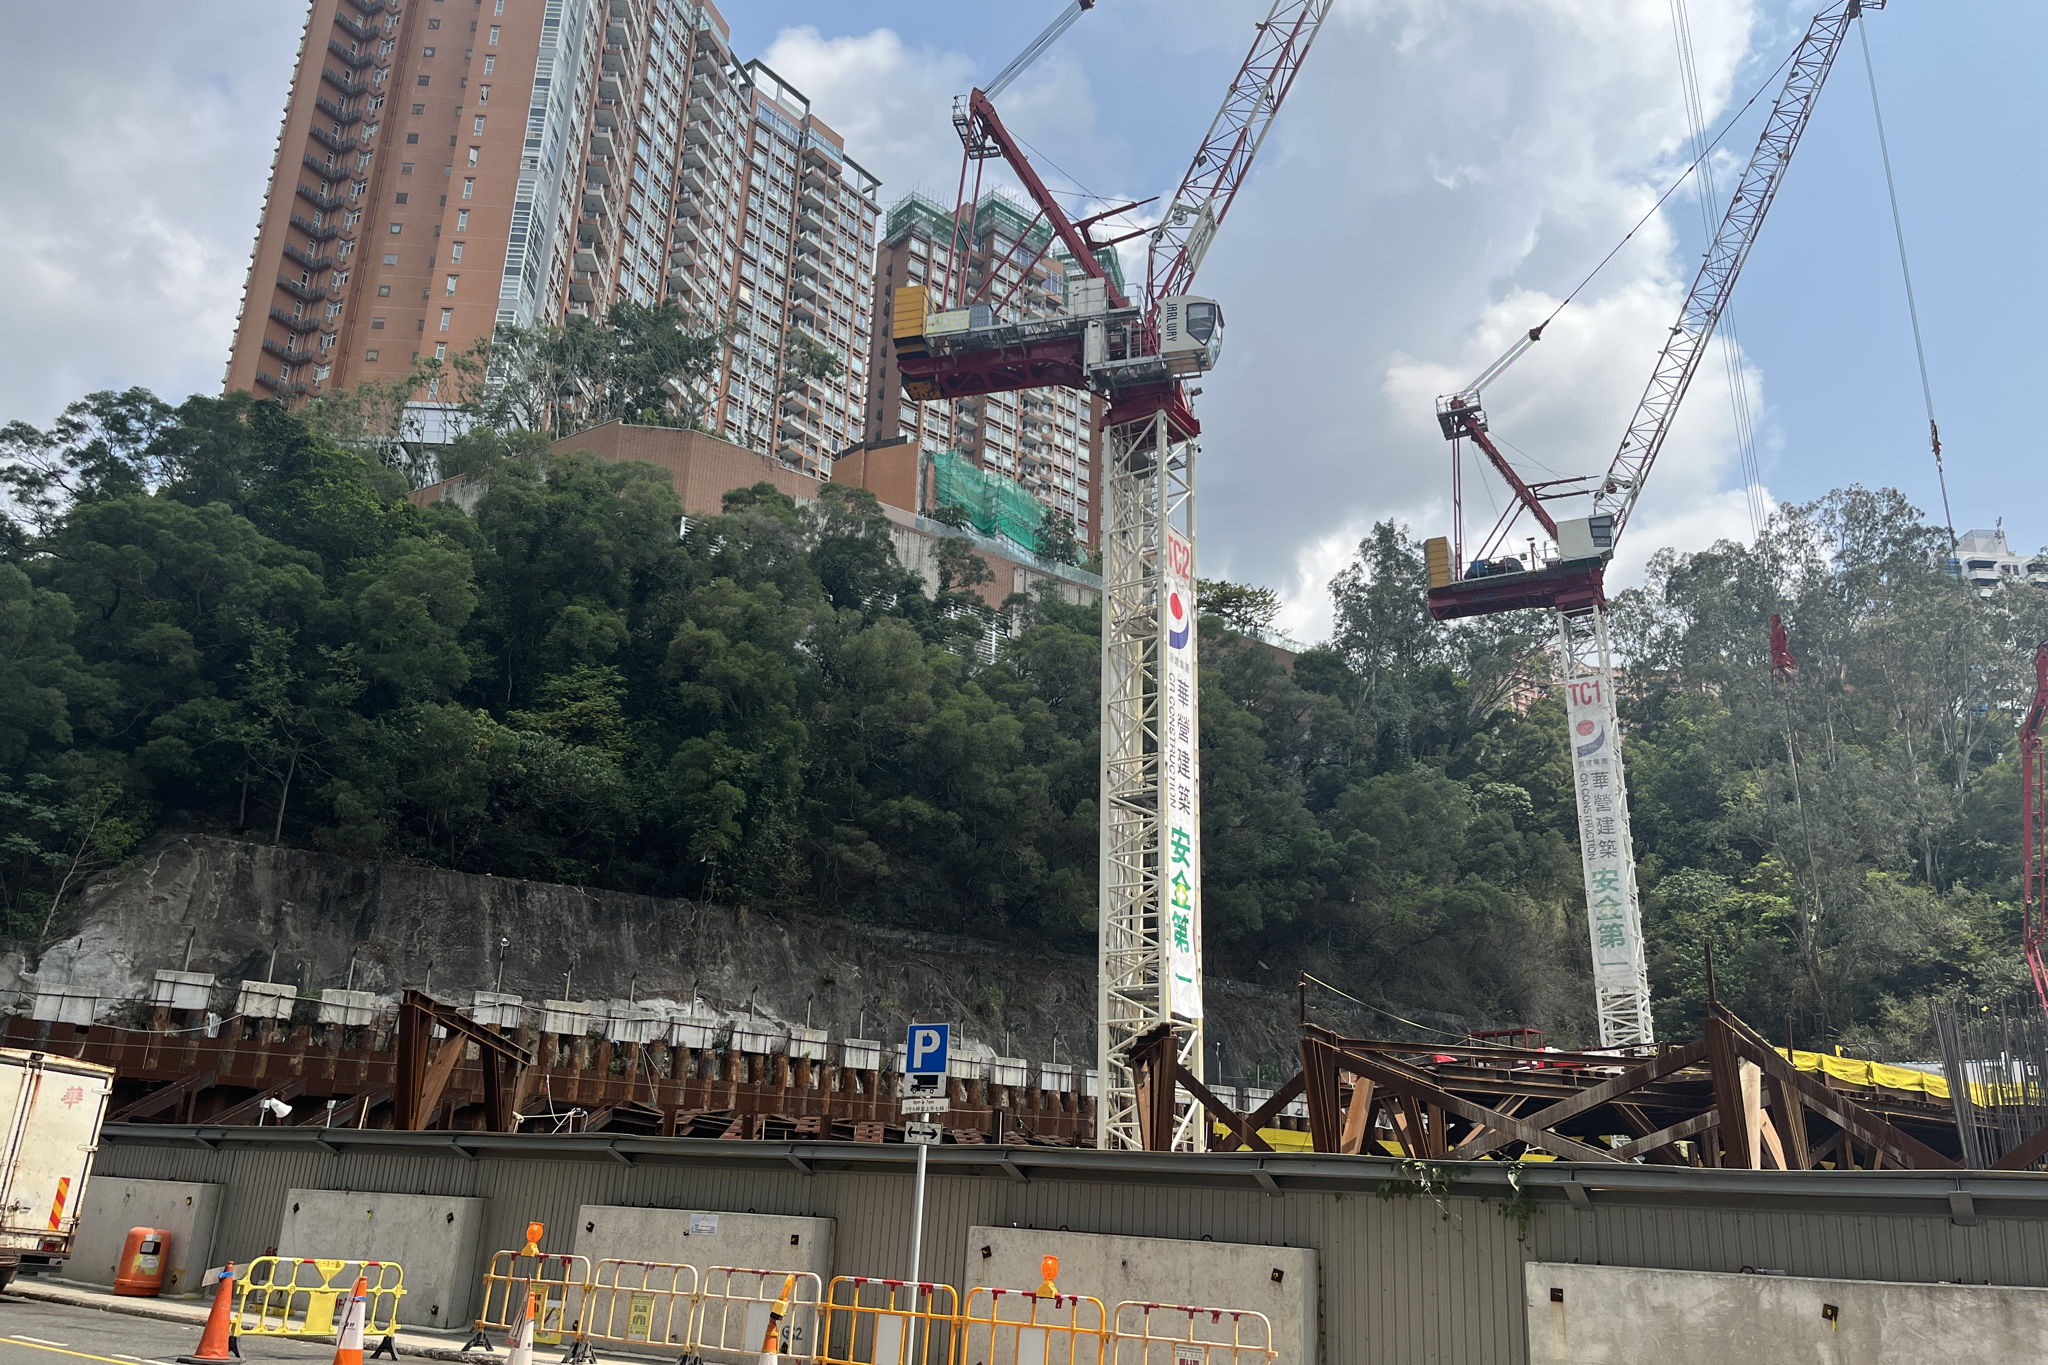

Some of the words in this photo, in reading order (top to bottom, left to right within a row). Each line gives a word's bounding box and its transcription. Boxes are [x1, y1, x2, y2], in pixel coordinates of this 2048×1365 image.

[1166, 302, 1178, 342] JARLWAY
[1168, 534, 1190, 581] TC2
[1568, 680, 1602, 706] TC1
[1168, 697, 1177, 808] CONSTRUCTION
[1177, 675, 1191, 816] 華營建築
[1580, 772, 1588, 787] CR
[1581, 788, 1597, 860] CONSTRUCTION
[1590, 771, 1617, 858] 華營建築
[1171, 826, 1192, 983] 安全第一
[1592, 867, 1628, 966] 安全第一
[913, 1030, 941, 1068] P
